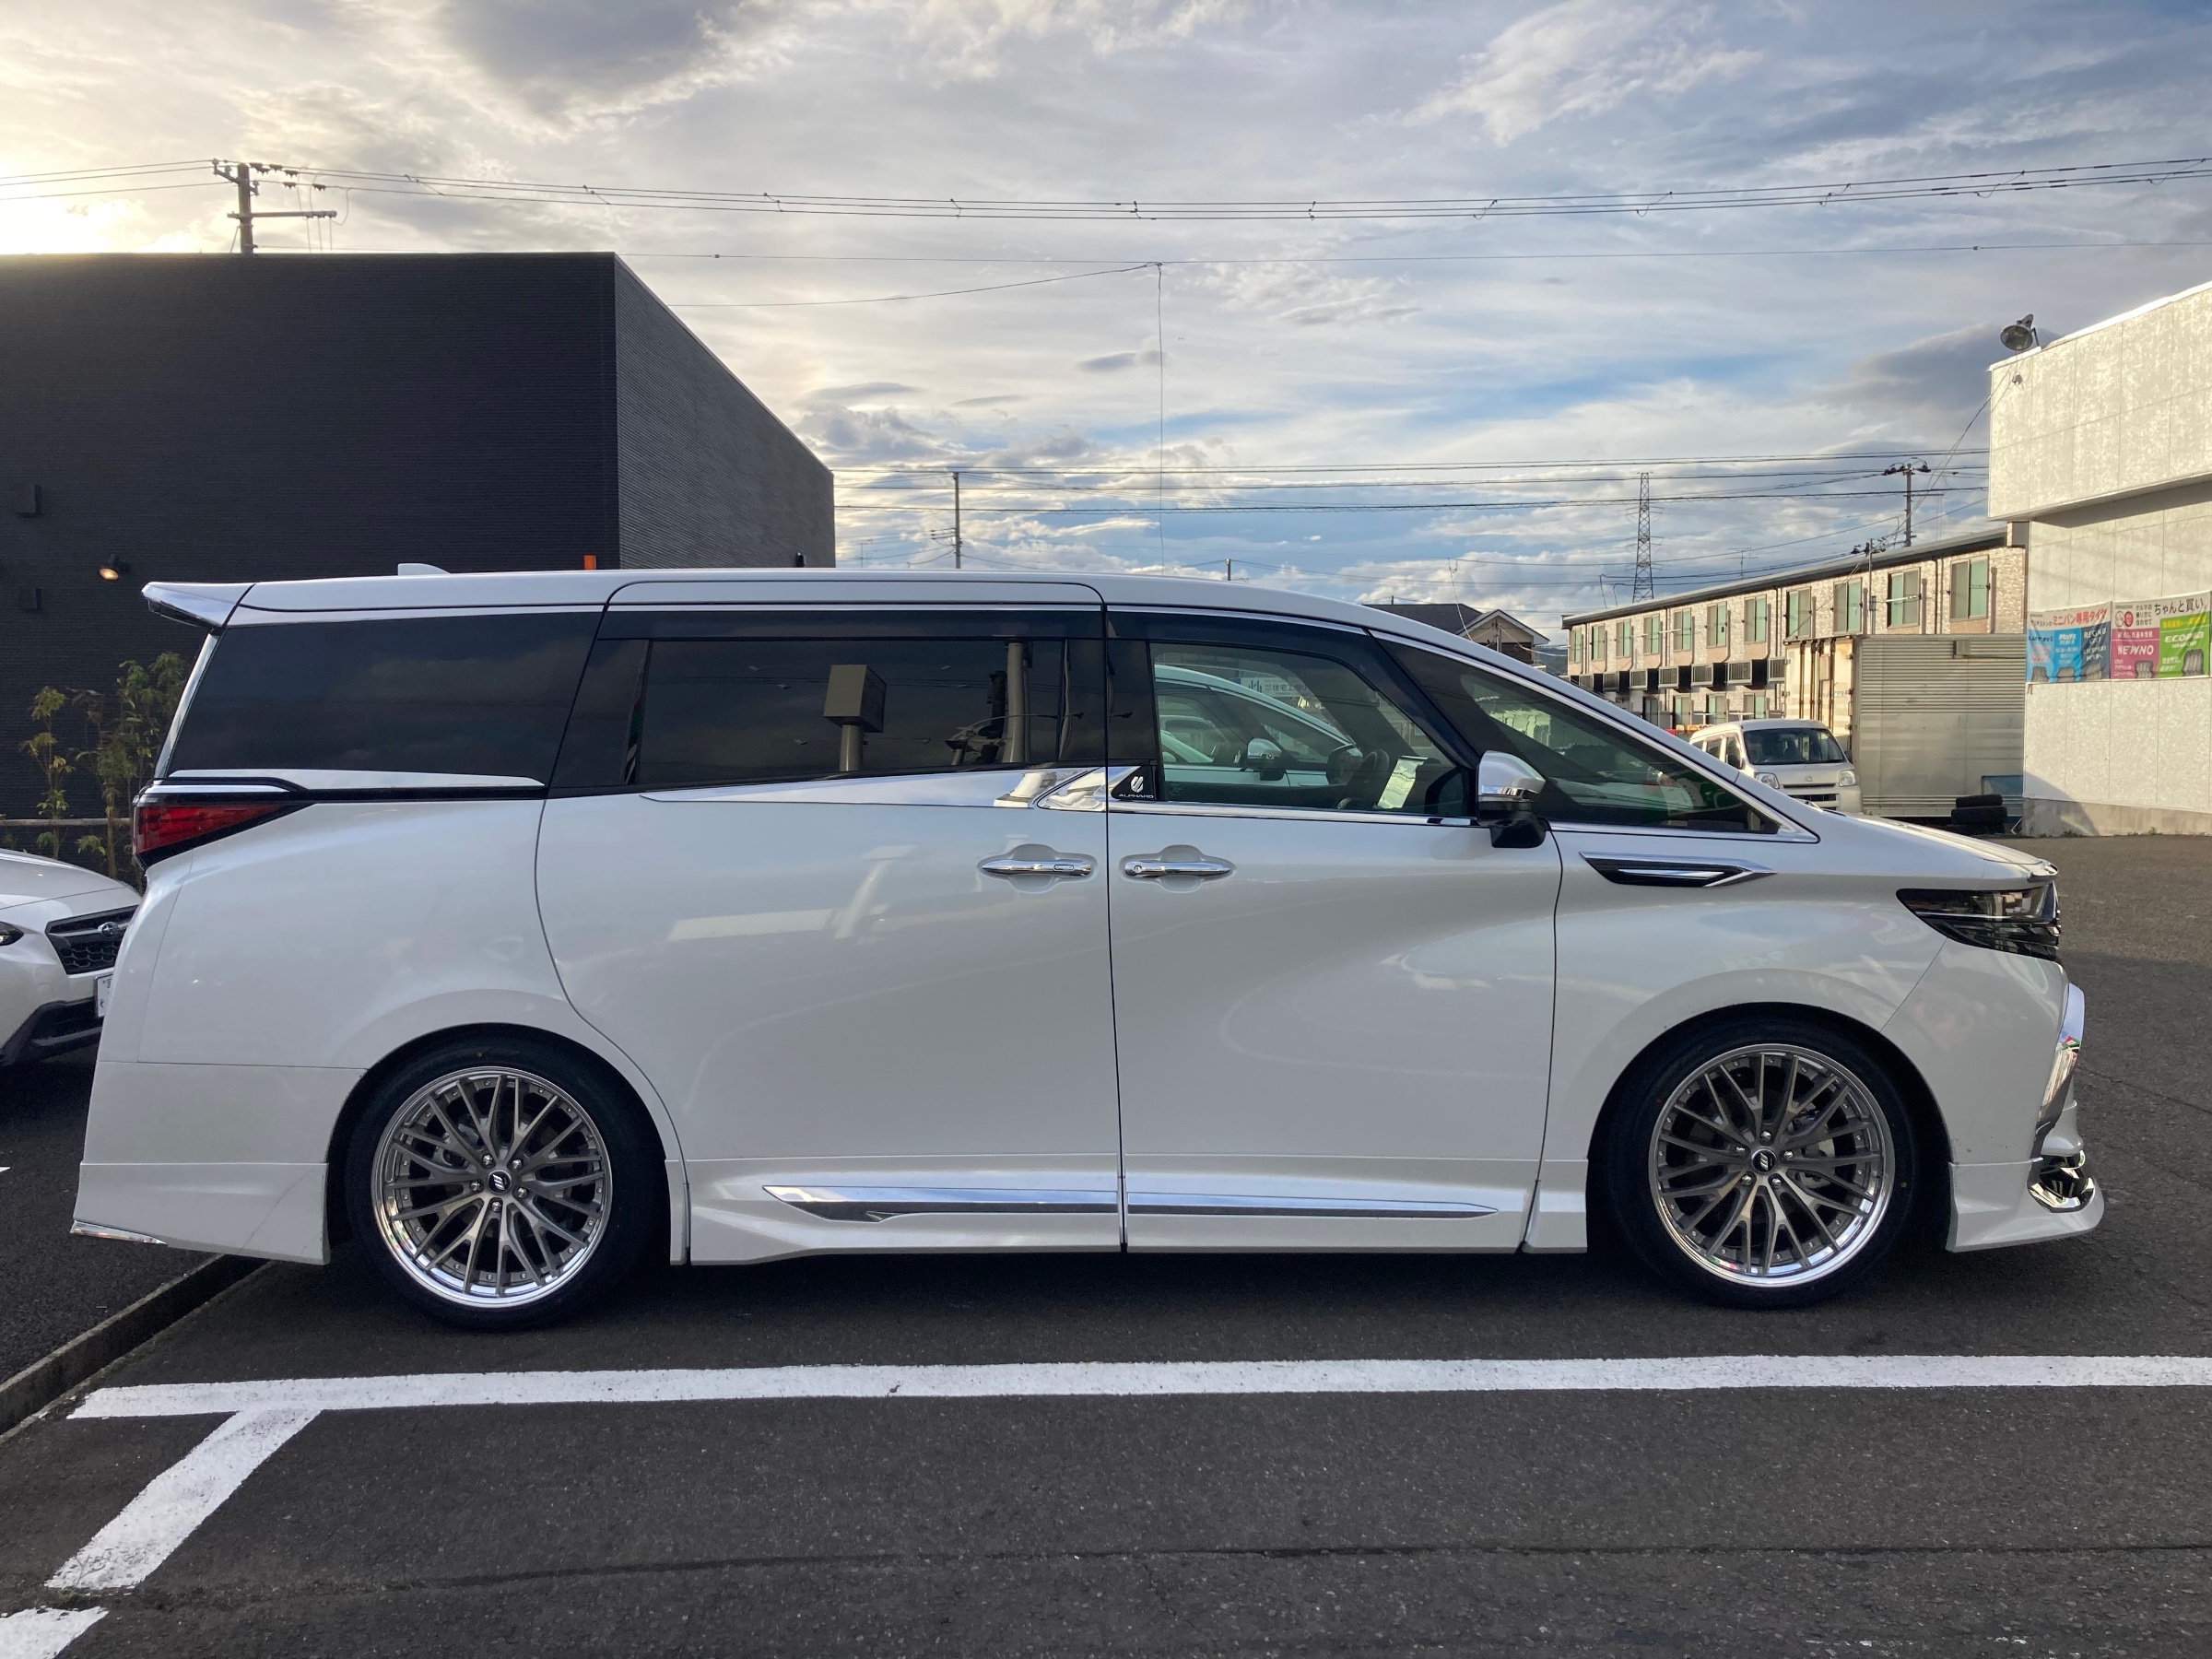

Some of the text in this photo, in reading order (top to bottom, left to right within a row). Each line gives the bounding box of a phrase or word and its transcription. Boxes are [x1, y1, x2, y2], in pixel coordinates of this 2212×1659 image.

[2154, 597, 2204, 616] ちゃんと買い
